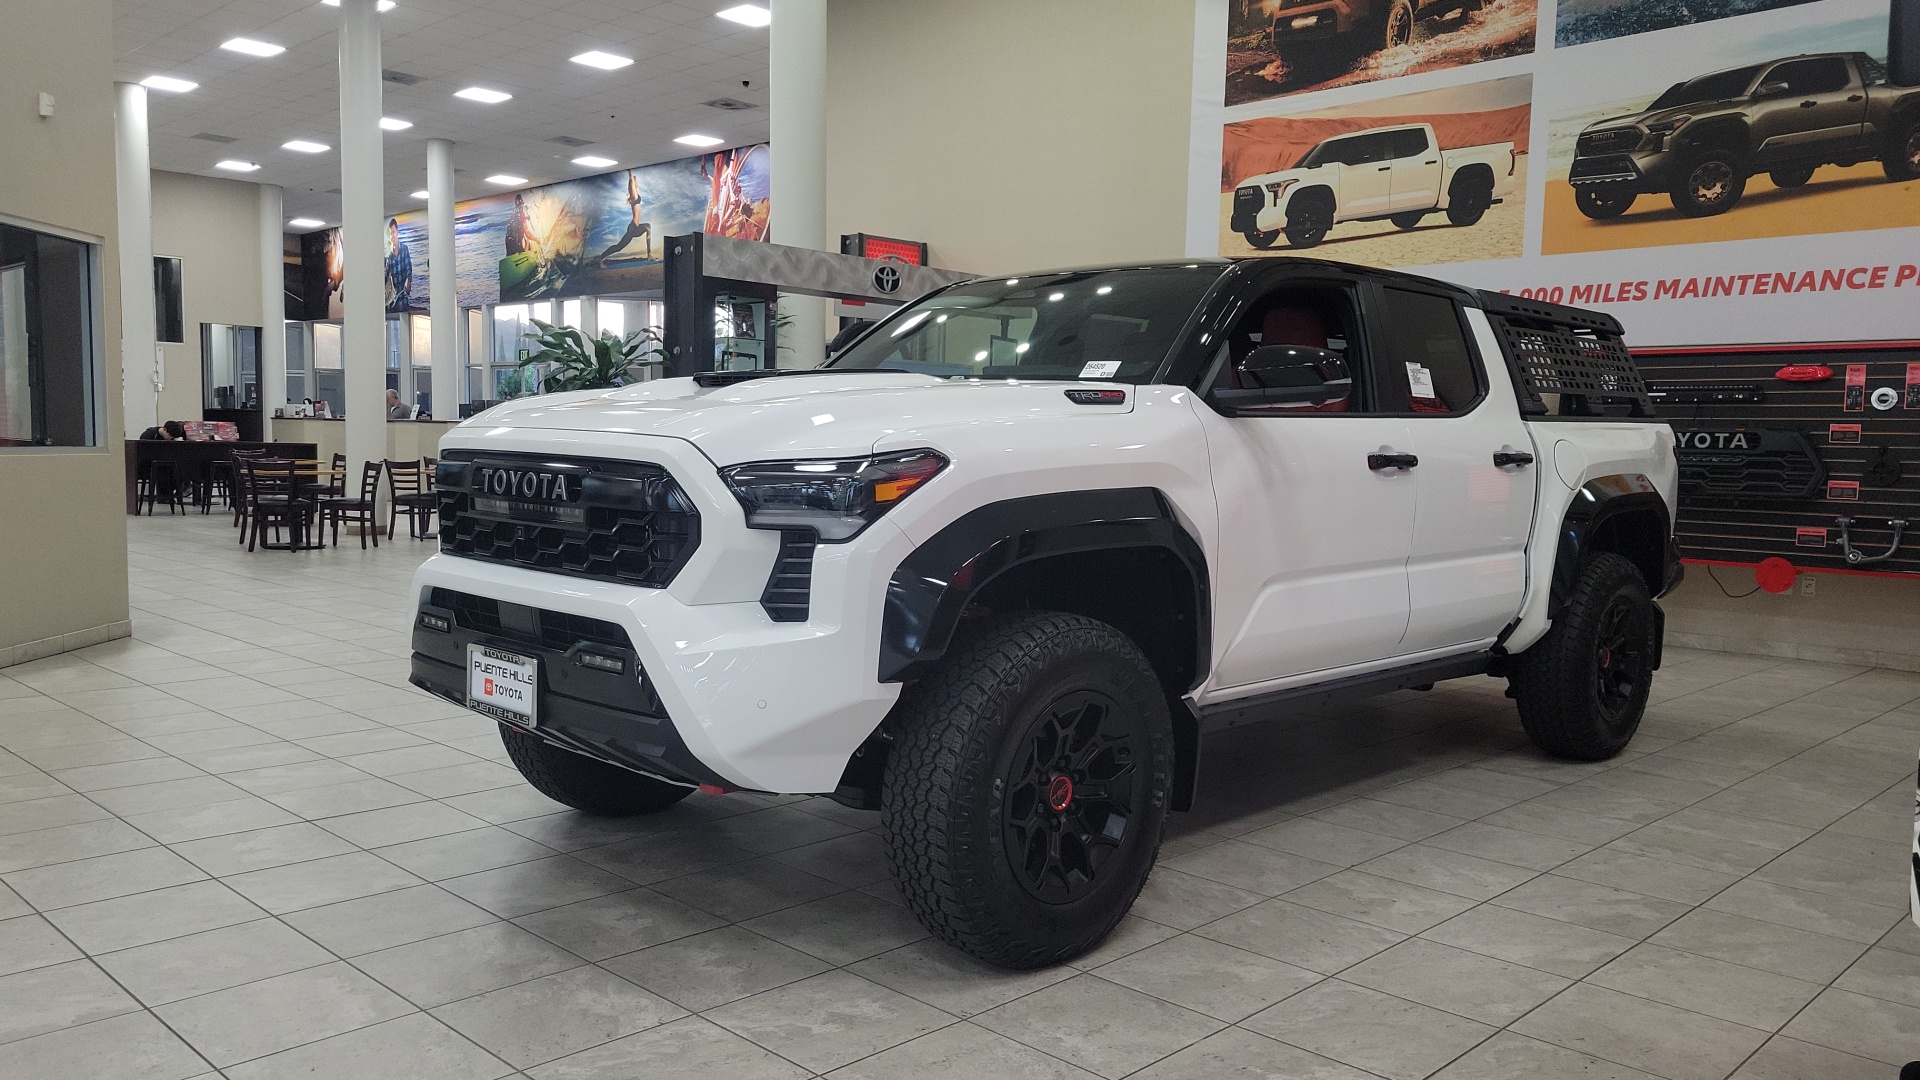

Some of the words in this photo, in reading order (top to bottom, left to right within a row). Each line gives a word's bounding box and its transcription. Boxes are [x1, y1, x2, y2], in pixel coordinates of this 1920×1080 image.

[1592, 132, 1615, 141] TOYOTA
[1569, 281, 1649, 305] MILES
[1653, 265, 1890, 301] MAINTENANCE
[1894, 264, 1920, 287] P
[1676, 432, 1748, 449] YOTA
[482, 468, 567, 501] TOYOTA
[484, 648, 520, 663] TOYOTA
[474, 661, 508, 679] PUENTE
[509, 669, 533, 685] HILLS
[494, 684, 524, 701] TOYOTA
[470, 700, 503, 716] PUENTE
[504, 710, 529, 725] HILLS
